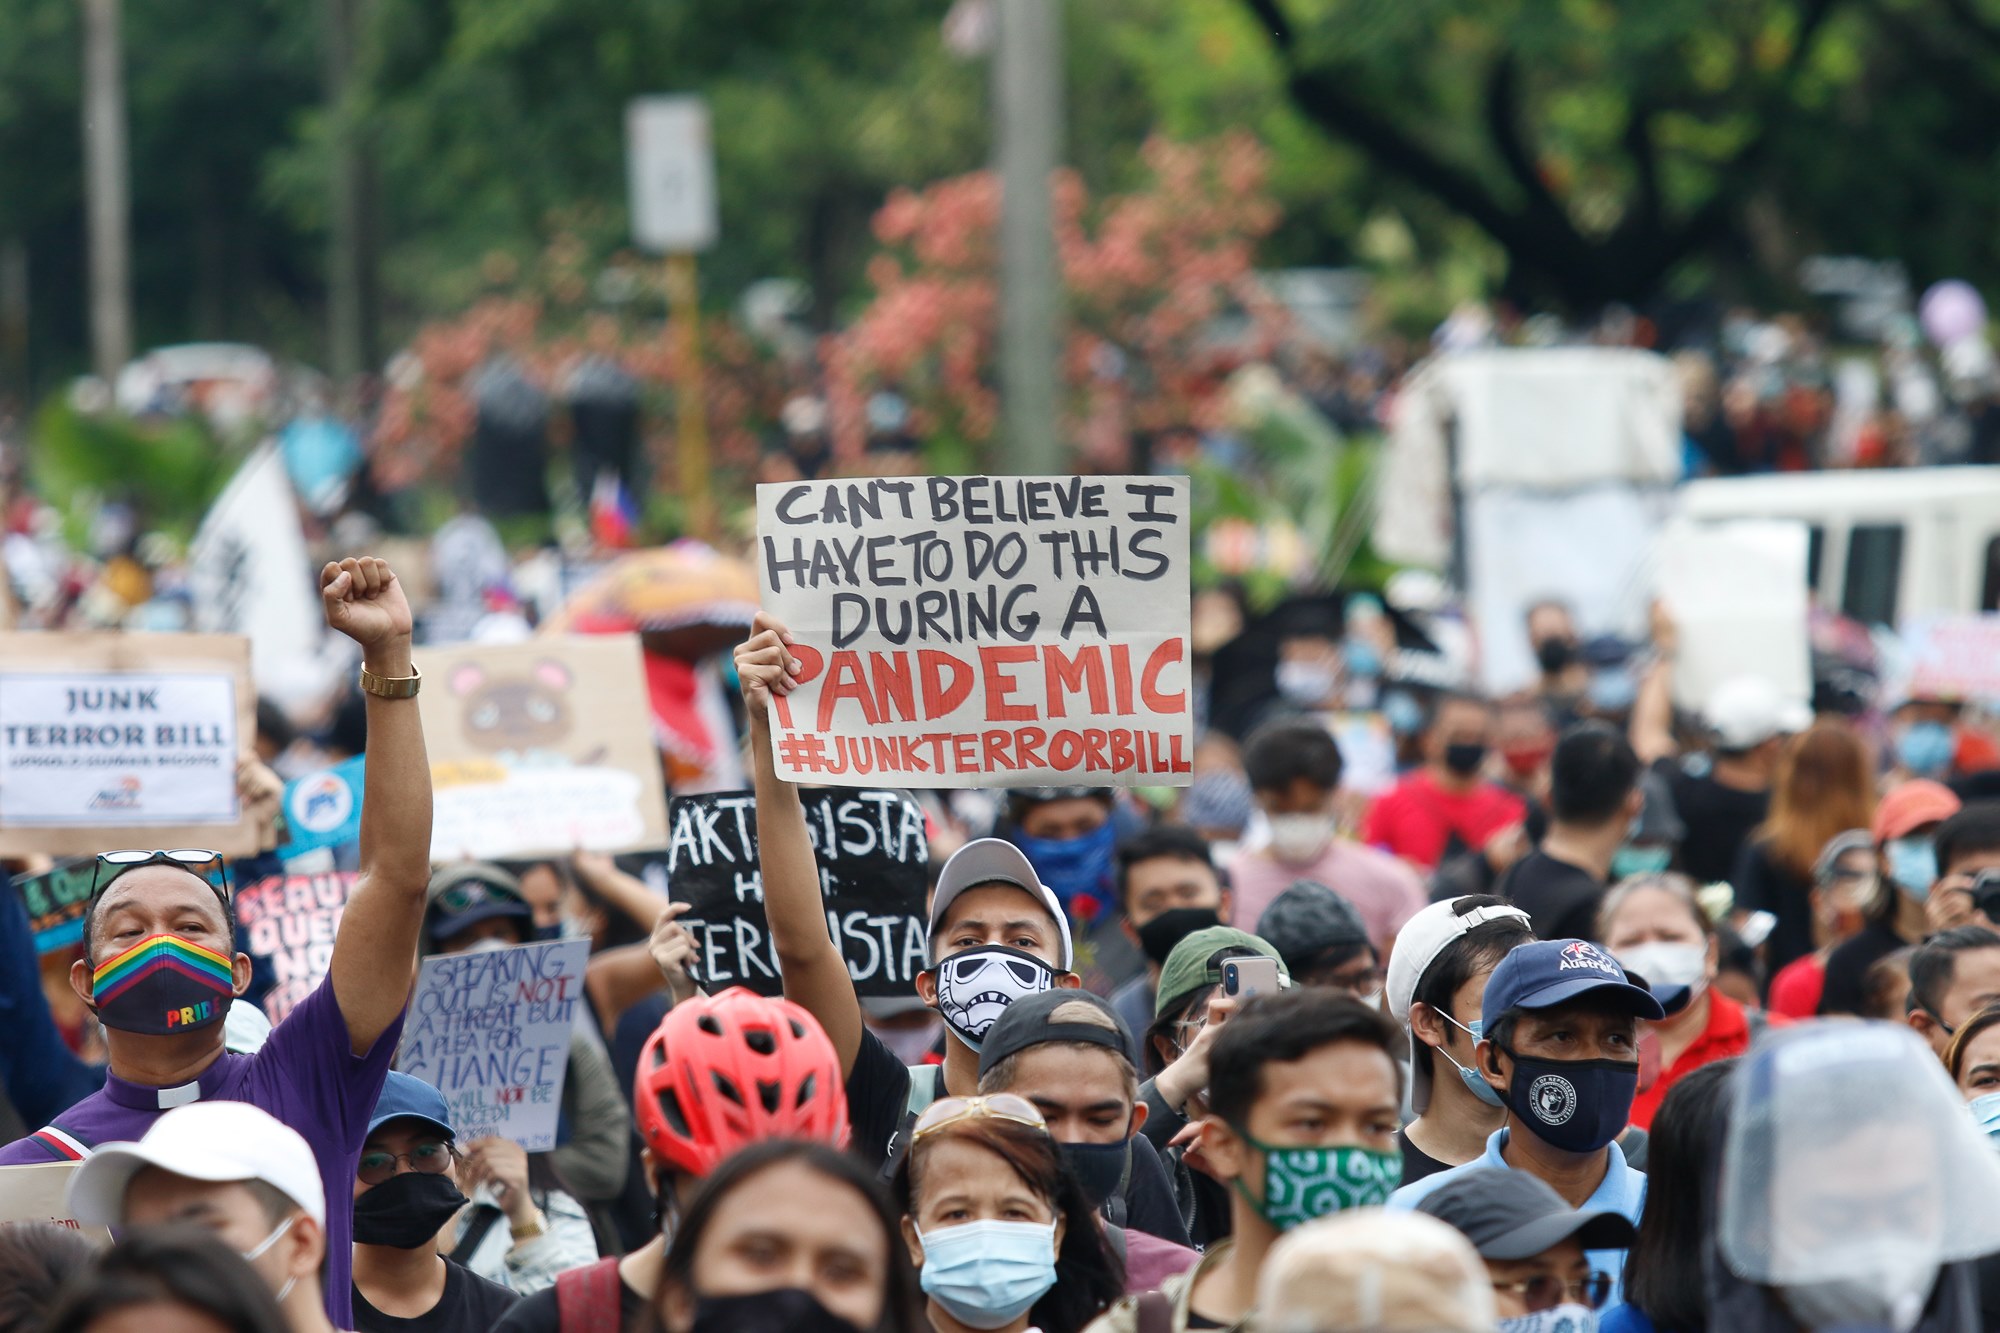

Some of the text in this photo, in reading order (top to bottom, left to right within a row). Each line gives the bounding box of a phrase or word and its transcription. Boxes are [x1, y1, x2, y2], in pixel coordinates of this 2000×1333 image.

[927, 476, 1109, 525] BELIEVE
[1126, 484, 1178, 524] I
[763, 526, 1170, 593] HAVE TO DO THIS
[832, 584, 1107, 649] DURING A
[67, 687, 159, 713] JUNK
[771, 638, 1187, 733] PANDEMIC
[6, 723, 225, 747] TERROR BILL
[778, 727, 1192, 775] #JUNKTERRORBILL
[669, 791, 929, 873] AKTISTA
[250, 906, 343, 958] QUE
[674, 911, 932, 981] TERISTA
[430, 944, 566, 989] SPEAKING
[167, 996, 221, 1028] PRIDE
[414, 996, 577, 1037] A THREAT BUT
[418, 974, 575, 1016] OUT IS NOT
[403, 1026, 523, 1061] A PLEA FOR
[495, 1086, 528, 1105] NOT
